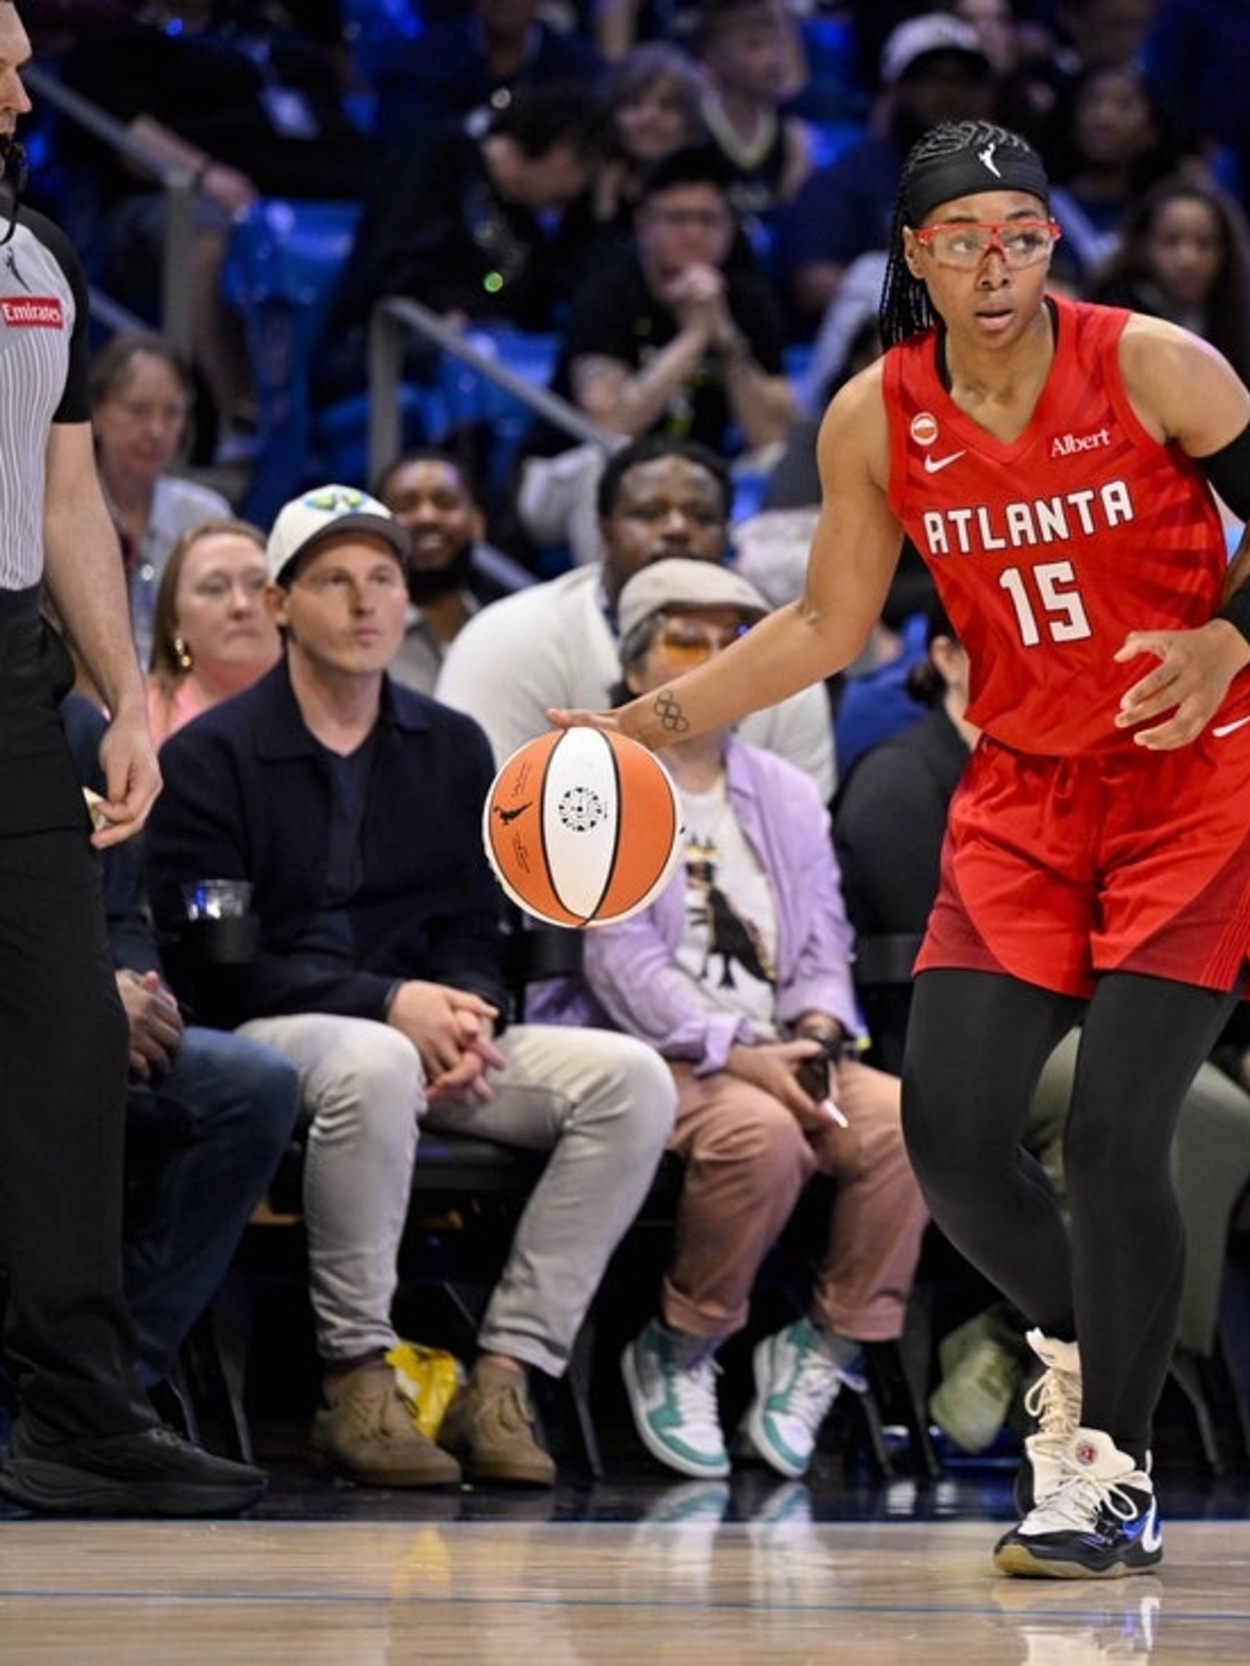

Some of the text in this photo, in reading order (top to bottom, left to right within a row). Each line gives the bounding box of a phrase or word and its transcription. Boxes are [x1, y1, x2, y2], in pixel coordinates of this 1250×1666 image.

[2, 301, 61, 323] Emirates
[1050, 428, 1111, 458] Albert
[922, 479, 1135, 555] ATLANTA
[998, 560, 1093, 647] 15
